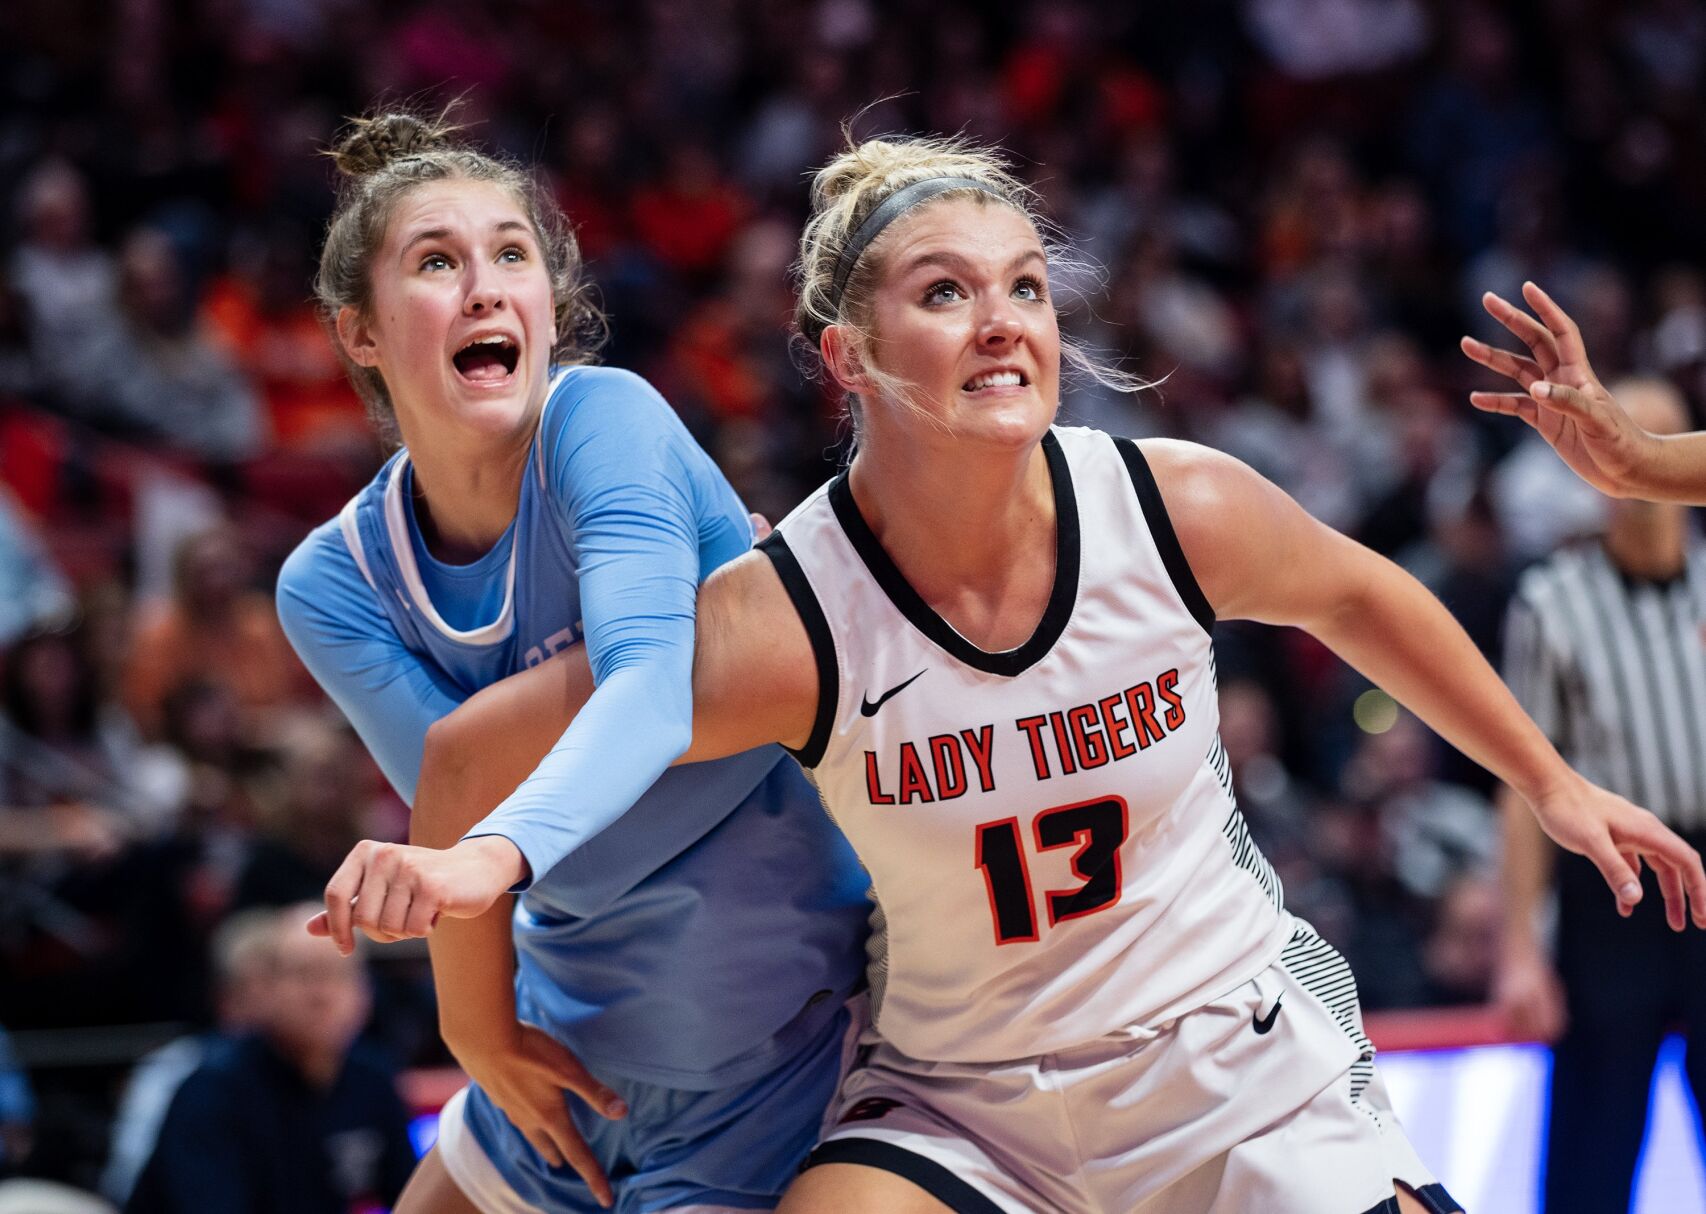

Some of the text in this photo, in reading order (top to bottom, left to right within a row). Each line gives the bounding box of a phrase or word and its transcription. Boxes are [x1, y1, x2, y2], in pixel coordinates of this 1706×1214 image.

[864, 668, 1186, 805] LADY TIGERS
[975, 794, 1129, 946] 13
